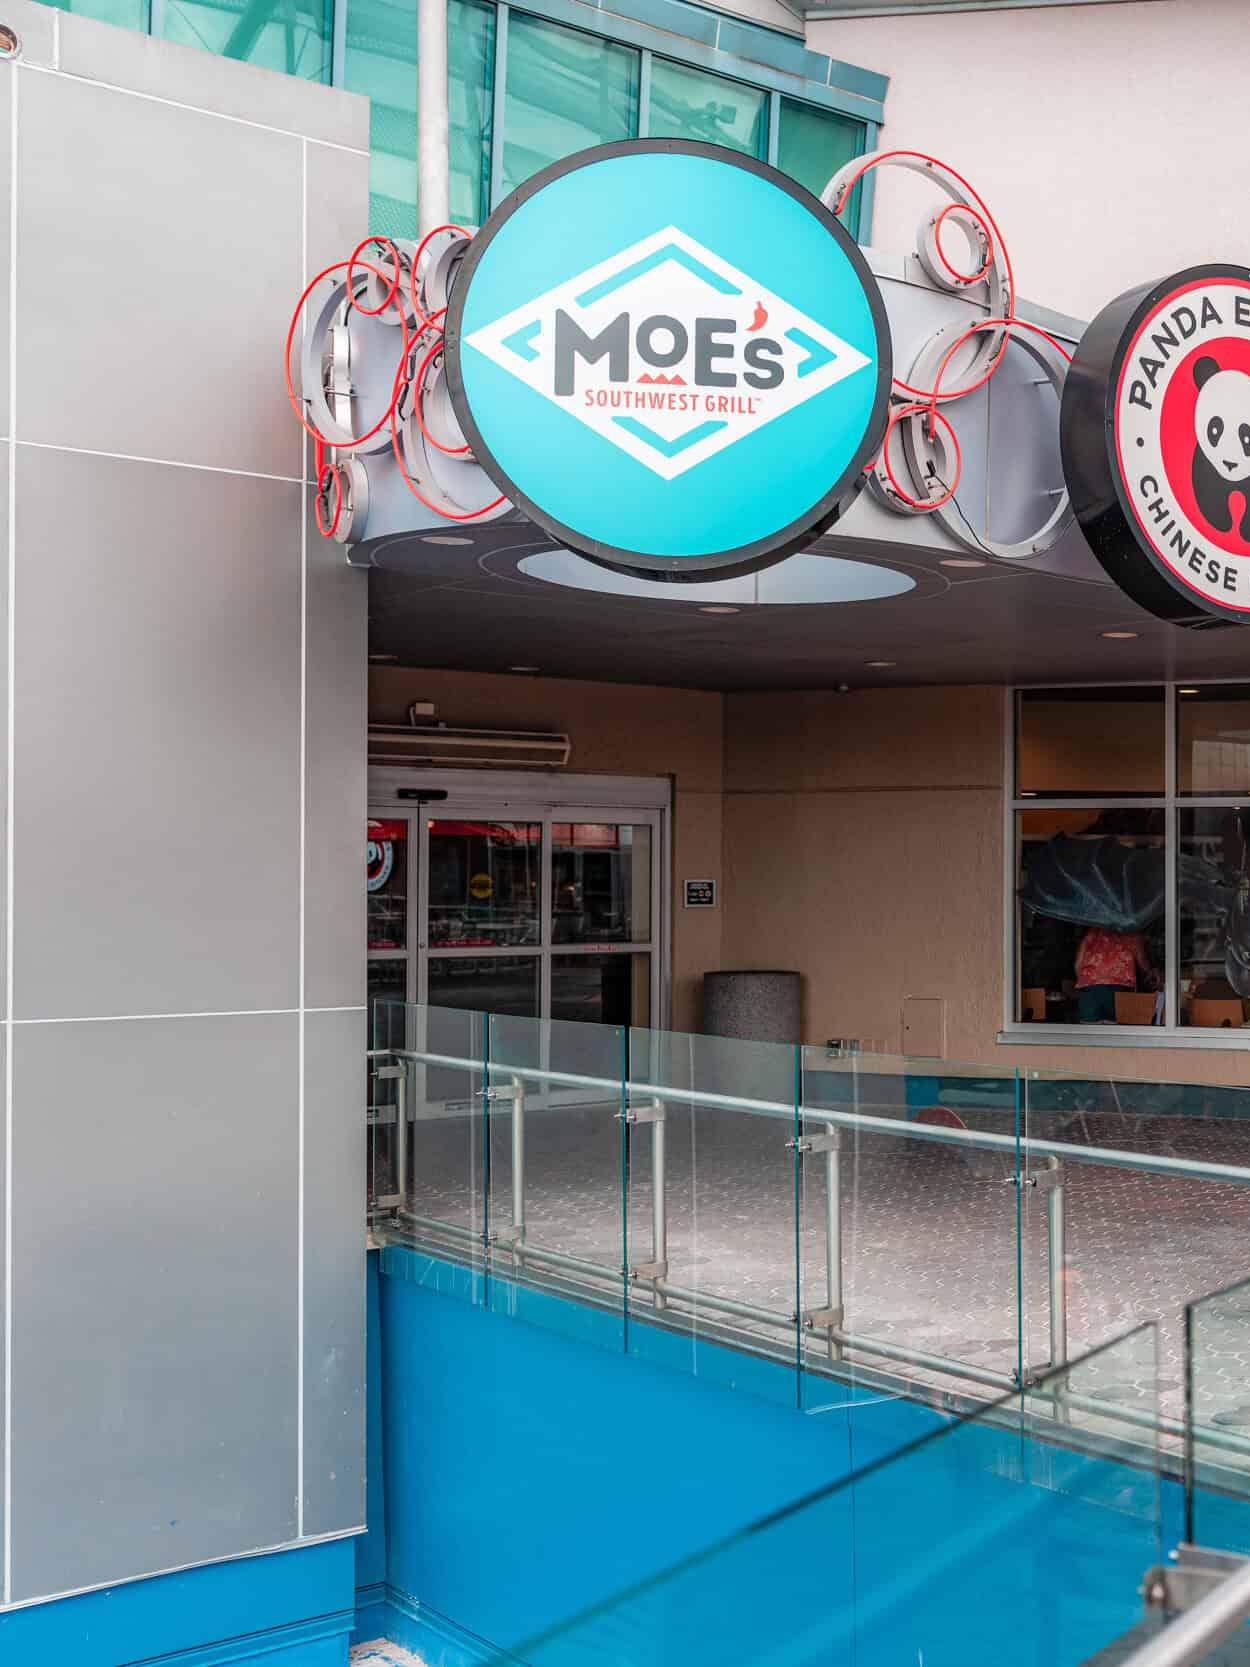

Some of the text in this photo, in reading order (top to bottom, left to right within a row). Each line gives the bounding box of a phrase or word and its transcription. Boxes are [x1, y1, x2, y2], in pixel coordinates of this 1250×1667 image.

[585, 389, 699, 412] SOUTHWEST
[1129, 296, 1223, 410] PANDA
[1140, 475, 1237, 591] CHINESE
